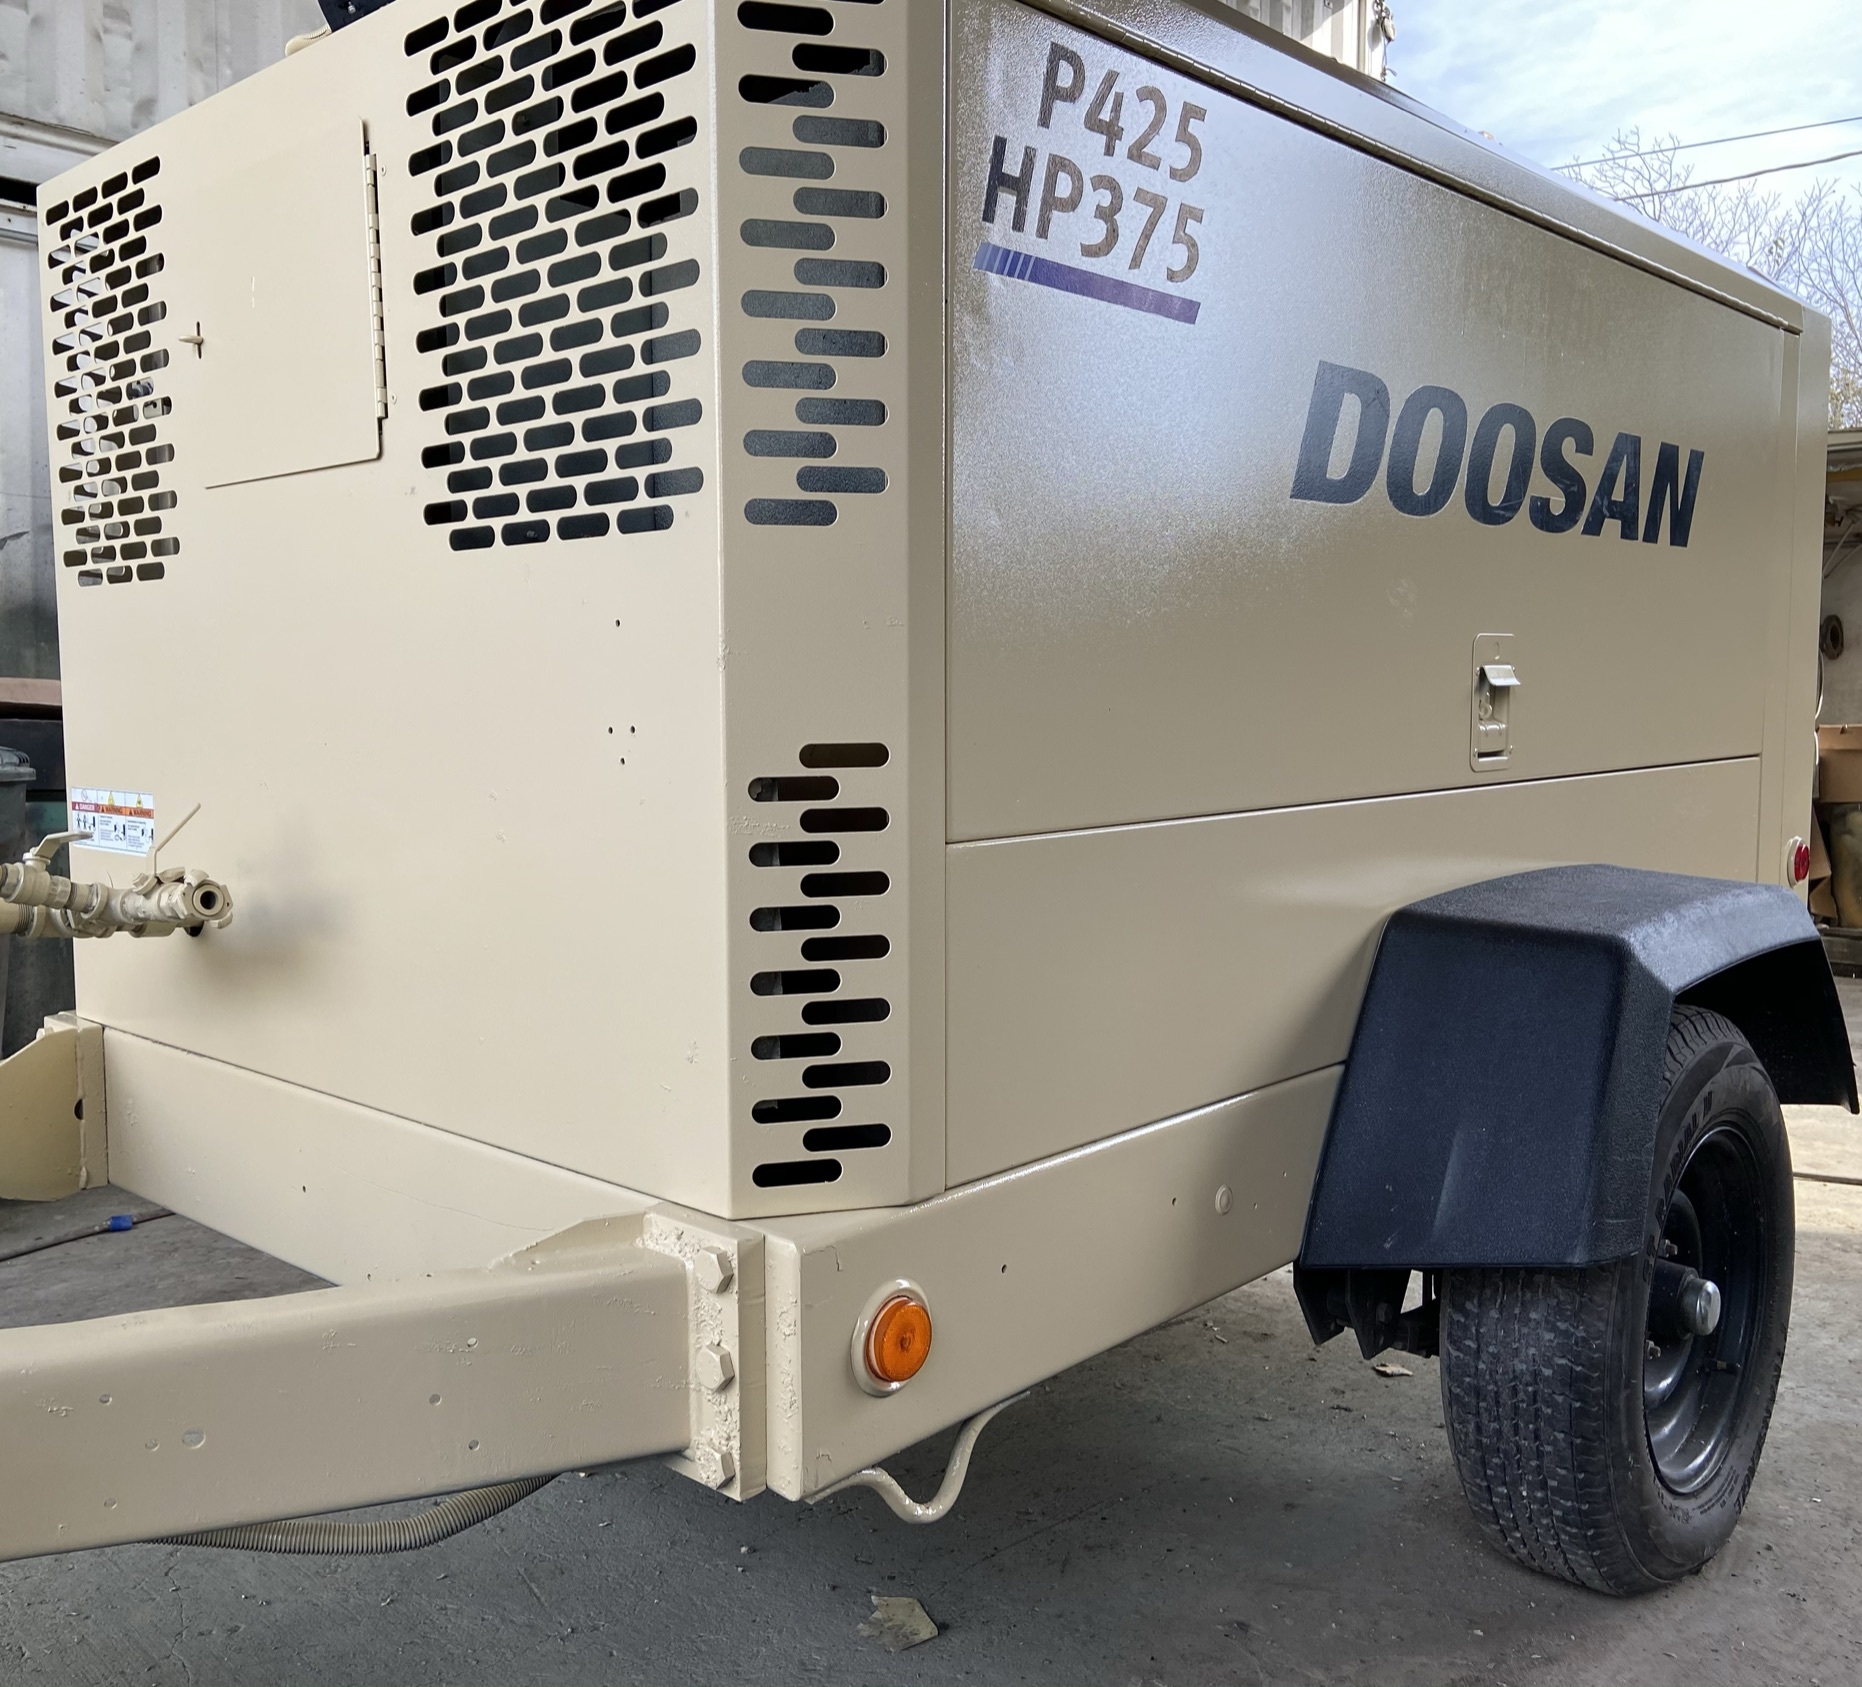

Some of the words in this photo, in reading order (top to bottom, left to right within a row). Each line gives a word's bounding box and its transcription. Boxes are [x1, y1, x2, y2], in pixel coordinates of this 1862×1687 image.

[1037, 41, 1207, 182] P425
[982, 135, 1204, 283] HP375
[1290, 360, 1704, 547] DOOSAN
[79, 803, 95, 811] DANGER
[106, 806, 124, 814] WARNING
[133, 809, 152, 817] WARNING
